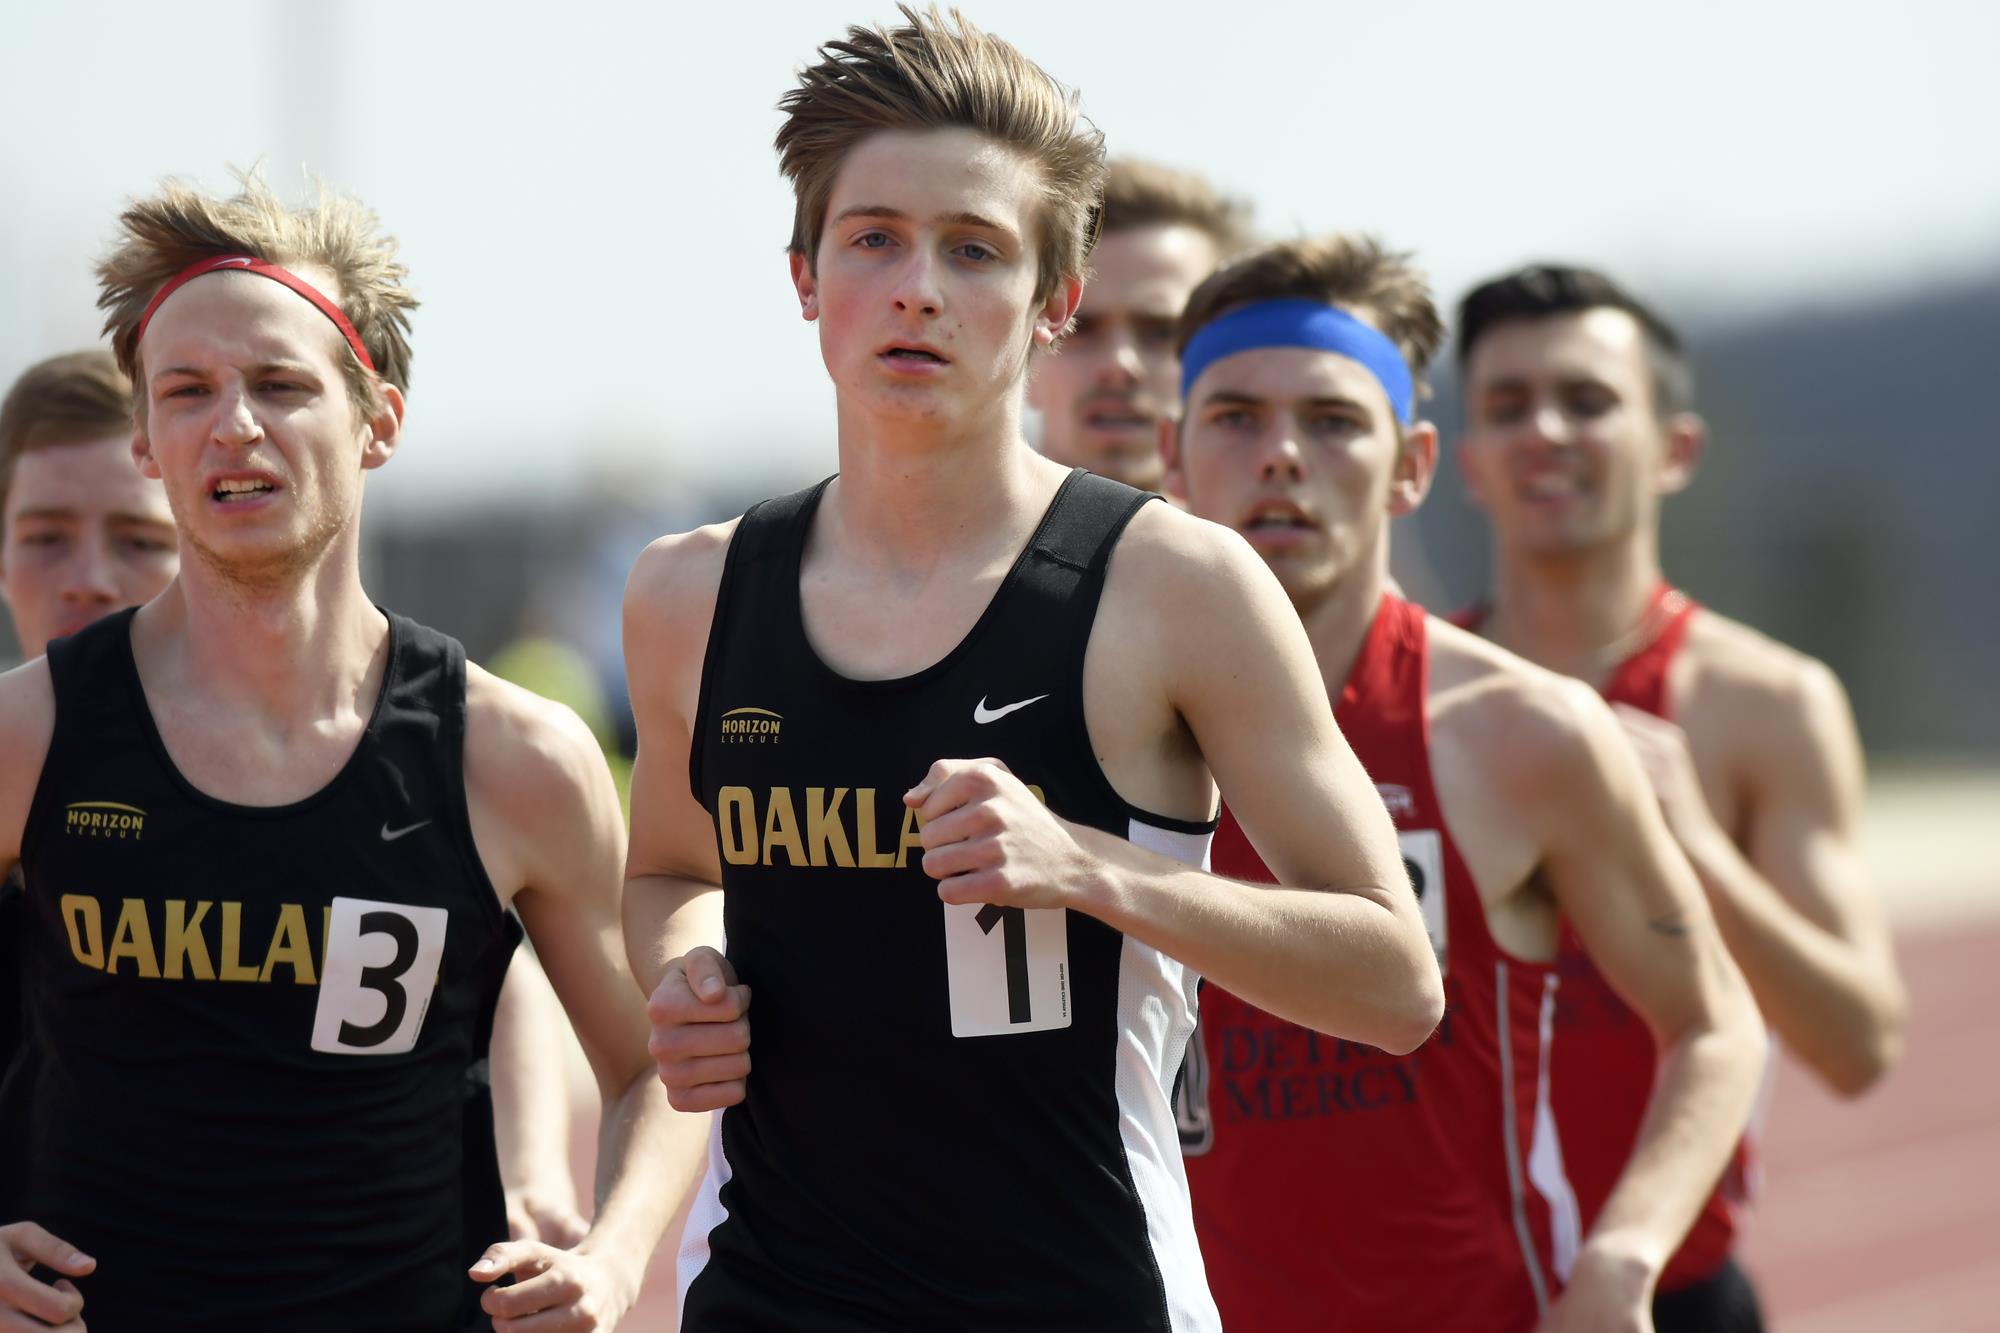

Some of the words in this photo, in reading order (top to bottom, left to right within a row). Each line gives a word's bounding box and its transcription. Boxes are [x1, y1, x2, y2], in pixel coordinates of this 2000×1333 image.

[721, 735, 779, 744] LEAGUE
[722, 719, 781, 734] HORIZON
[67, 809, 144, 831] HORIZON
[717, 785, 1045, 868] OAKLA
[60, 893, 439, 985] OAKLA
[974, 902, 1032, 1025] 1
[337, 911, 419, 1048] 3
[1223, 1057, 1421, 1123] MERCY
